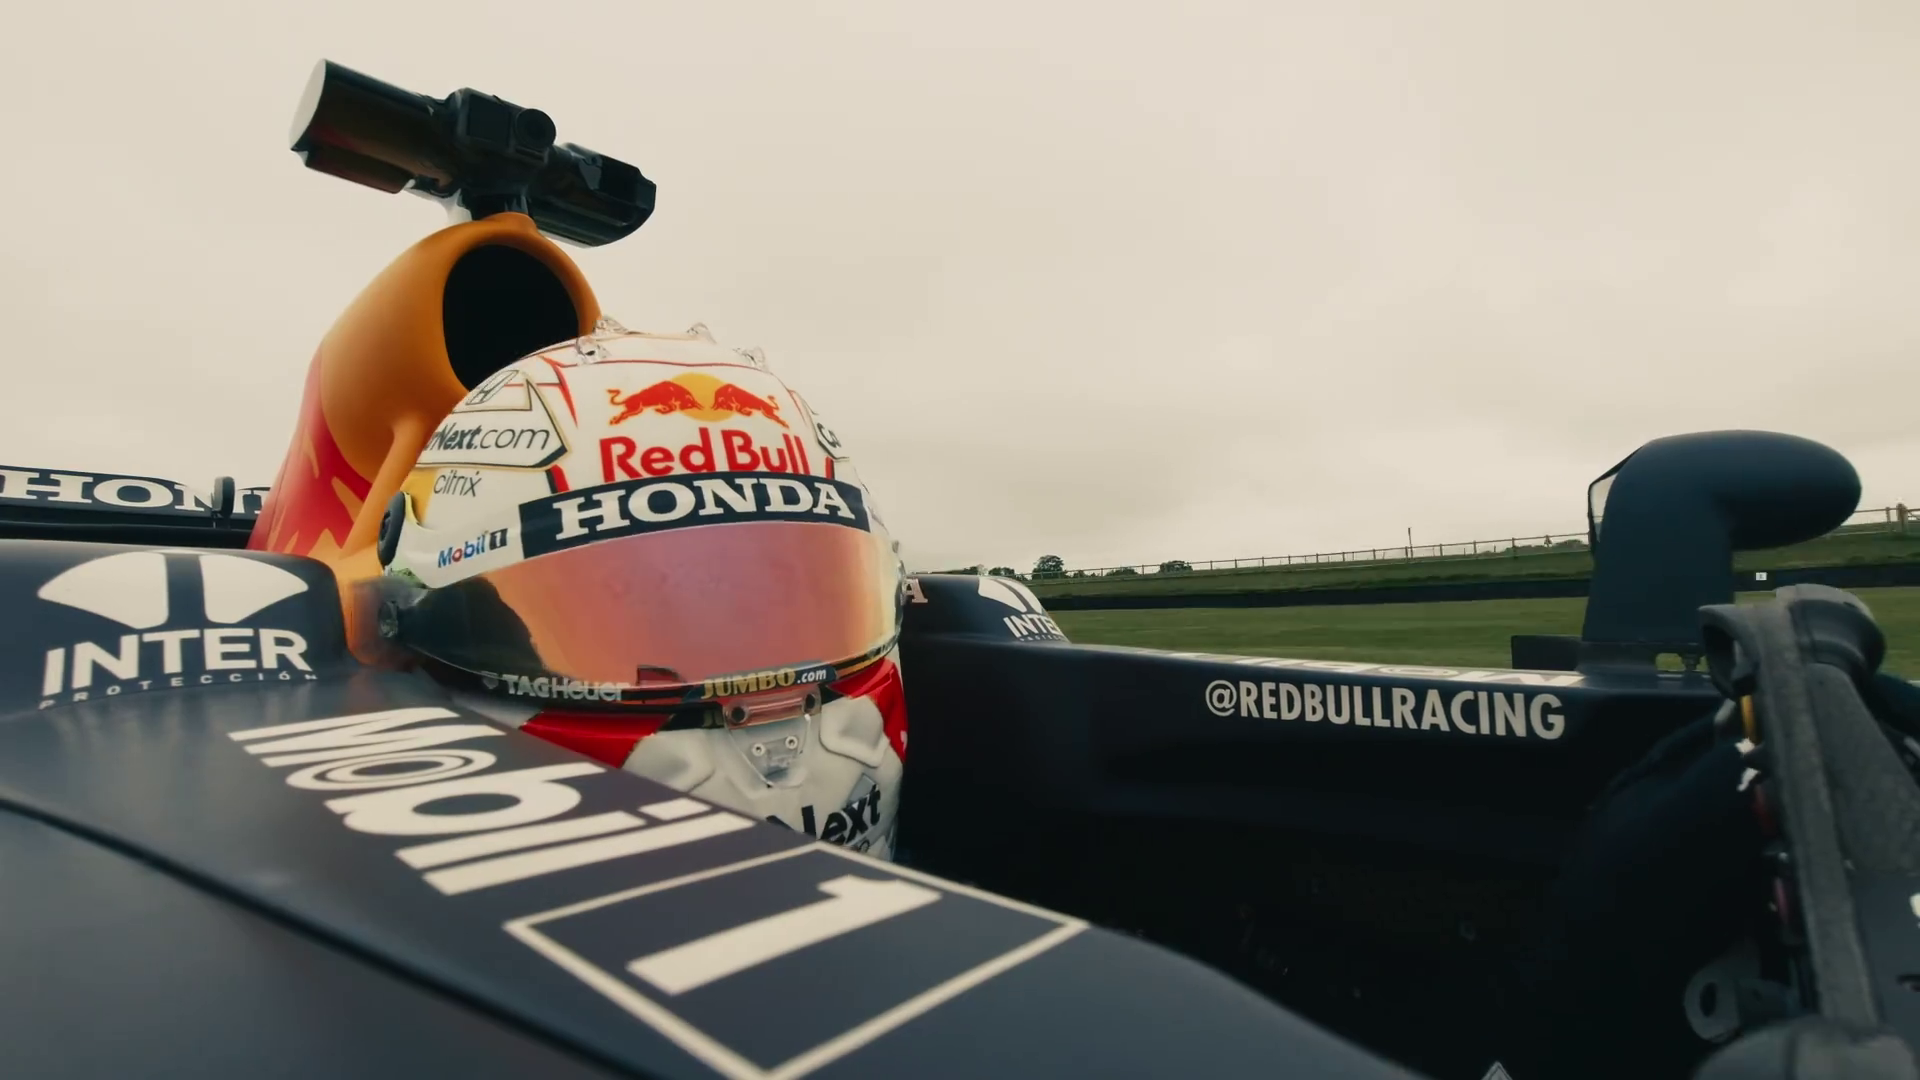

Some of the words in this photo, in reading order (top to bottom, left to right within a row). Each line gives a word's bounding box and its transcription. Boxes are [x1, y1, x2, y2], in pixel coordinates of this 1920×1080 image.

[599, 427, 716, 483] Red
[721, 429, 810, 475] Bull
[0, 469, 264, 515] HON
[433, 469, 482, 497] citrix
[553, 478, 855, 540] HONDA
[437, 533, 486, 568] Mobil
[1003, 614, 1062, 638] INTE
[42, 628, 313, 697] INTER
[38, 672, 318, 710] PROTECCIÓN
[1205, 680, 1566, 740] @REDBULLRACING
[228, 707, 756, 895] Mobil
[626, 873, 943, 996] 1
